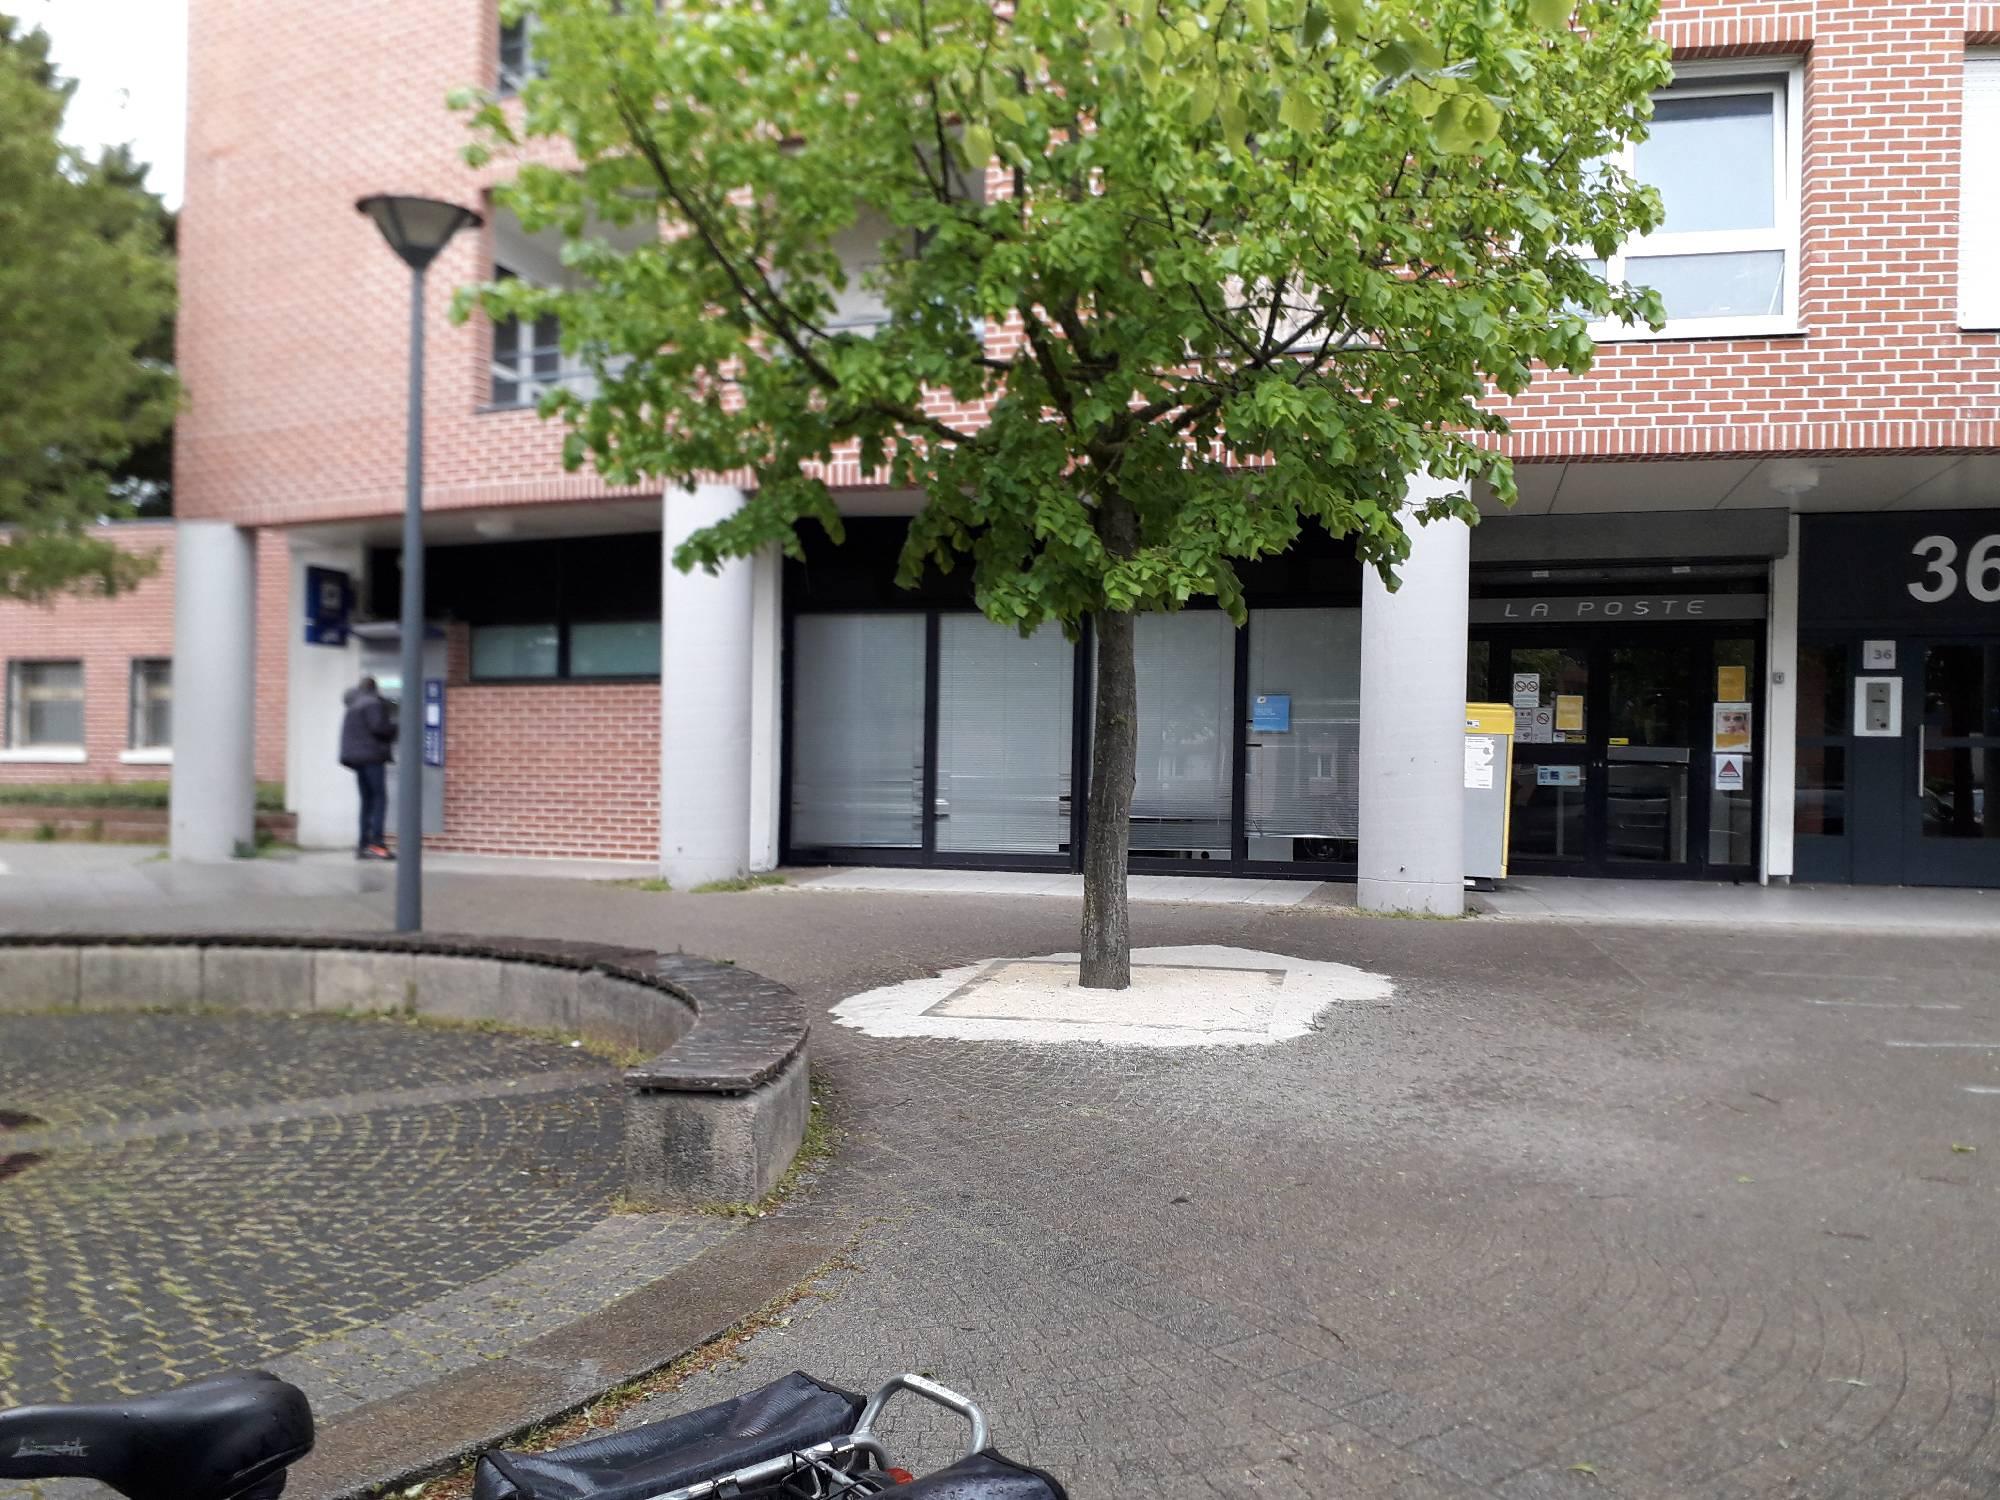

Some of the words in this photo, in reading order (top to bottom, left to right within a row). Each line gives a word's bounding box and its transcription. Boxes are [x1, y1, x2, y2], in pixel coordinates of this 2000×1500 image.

[1906, 535, 2000, 603] 36
[1503, 603, 1549, 617] LA
[1577, 600, 1705, 617] POSTE
[1873, 649, 1893, 660] 36
